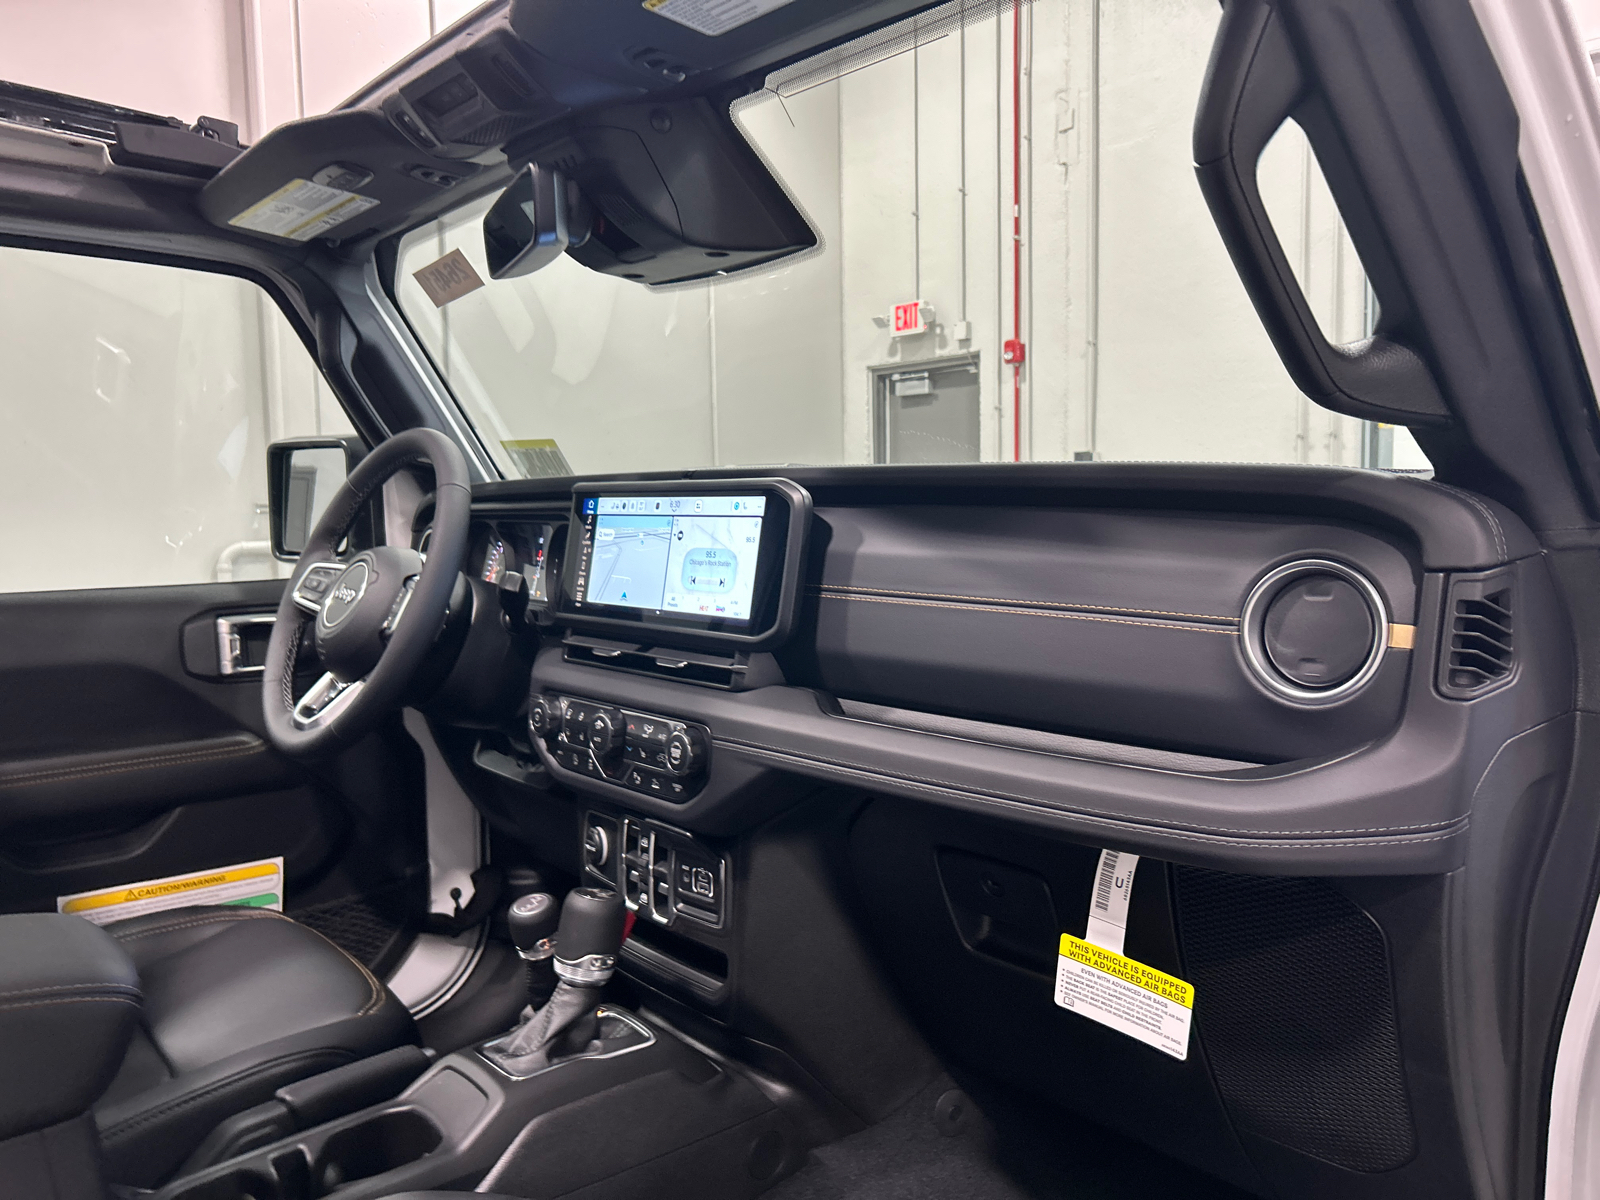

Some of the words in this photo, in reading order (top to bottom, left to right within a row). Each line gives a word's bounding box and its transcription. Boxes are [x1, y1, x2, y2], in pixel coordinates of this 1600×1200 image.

[895, 302, 919, 331] EXIT
[705, 550, 716, 558] 95.5
[1068, 948, 1091, 963] WITH
[1092, 958, 1141, 984] ADVANCED
[1143, 979, 1159, 992] AIR
[1161, 987, 1185, 1004] BAGS
[1069, 940, 1089, 954] THIS
[1090, 948, 1128, 970] VEHICLE
[1130, 964, 1139, 974] IS
[1141, 969, 1187, 994] EQUIPPED
[1081, 967, 1095, 978] EVEN
[1096, 973, 1110, 984] WITH
[1111, 980, 1141, 997] ADVANCED
[1142, 993, 1151, 1001] AIR
[1152, 997, 1167, 1008] BAGS
